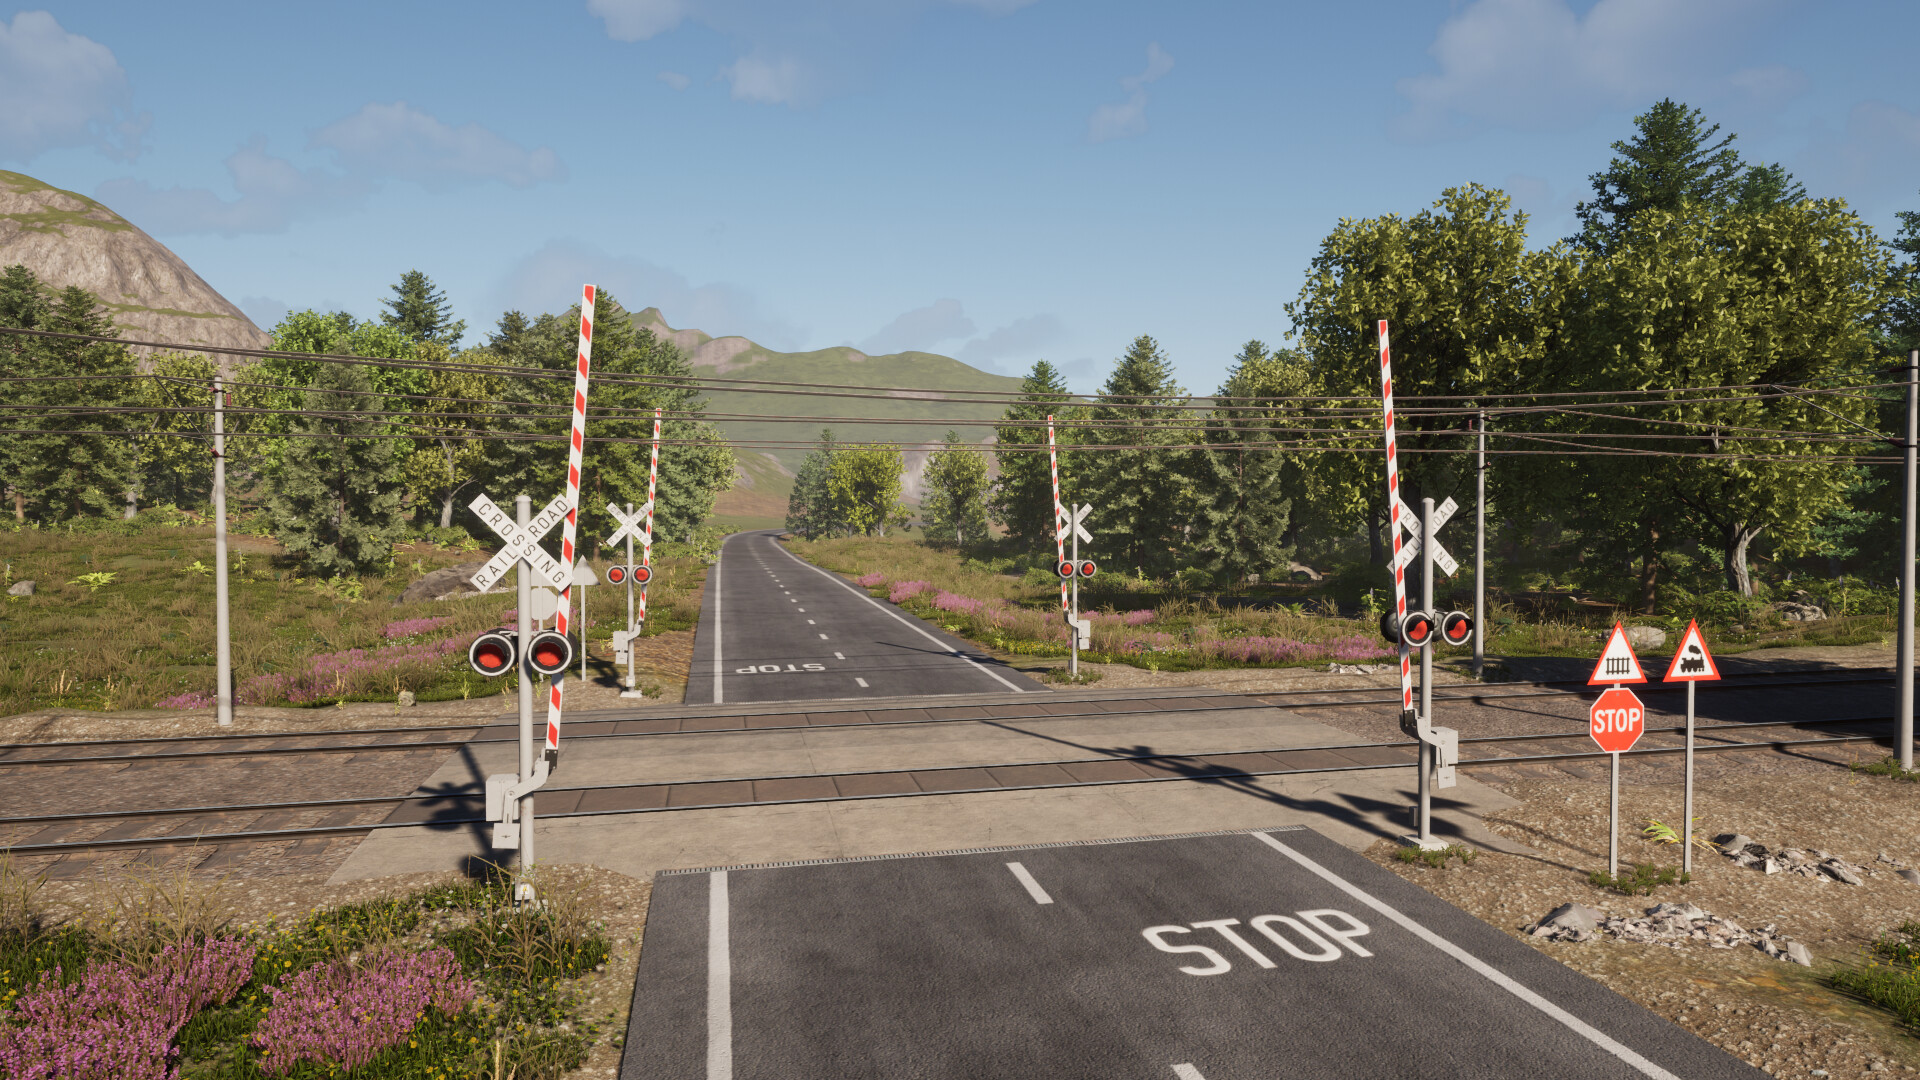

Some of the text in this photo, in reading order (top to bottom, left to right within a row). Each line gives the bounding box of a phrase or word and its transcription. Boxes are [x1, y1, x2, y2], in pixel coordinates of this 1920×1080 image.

[1433, 502, 1455, 530] OAD
[476, 500, 568, 587] RAIL ROAD
[478, 503, 565, 583] CROSSING
[735, 663, 826, 674] STOP
[1593, 707, 1641, 734] STOP
[1142, 908, 1374, 976] STOP
